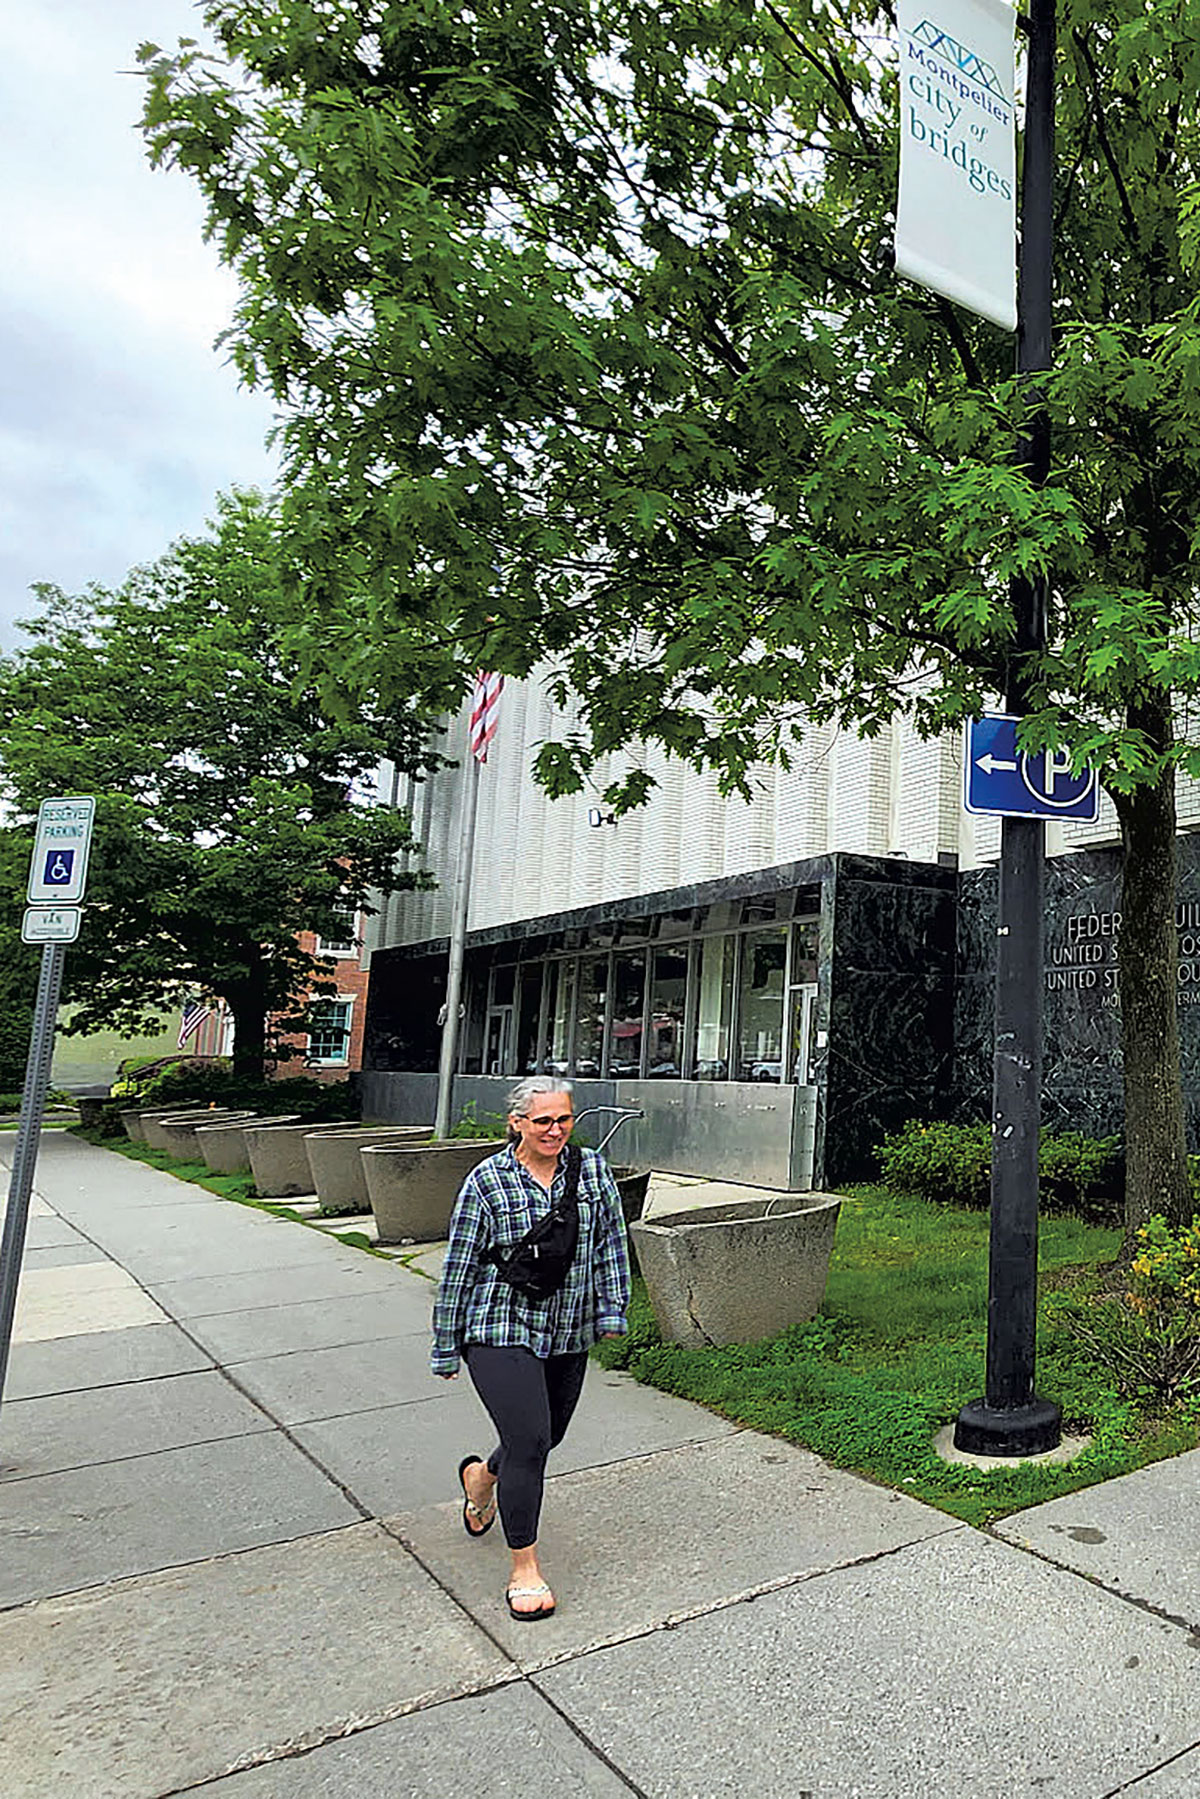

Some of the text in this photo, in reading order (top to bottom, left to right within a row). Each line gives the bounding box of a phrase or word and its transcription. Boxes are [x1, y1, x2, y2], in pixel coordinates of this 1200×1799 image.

[907, 40, 1011, 127] Montpelier
[908, 73, 963, 128] city
[969, 123, 989, 142] of
[908, 106, 1013, 201] bridges
[44, 825, 84, 838] PARKING
[1068, 911, 1122, 939] FEDER
[1052, 944, 1103, 965] UNITED
[1046, 970, 1097, 991] UNITED
